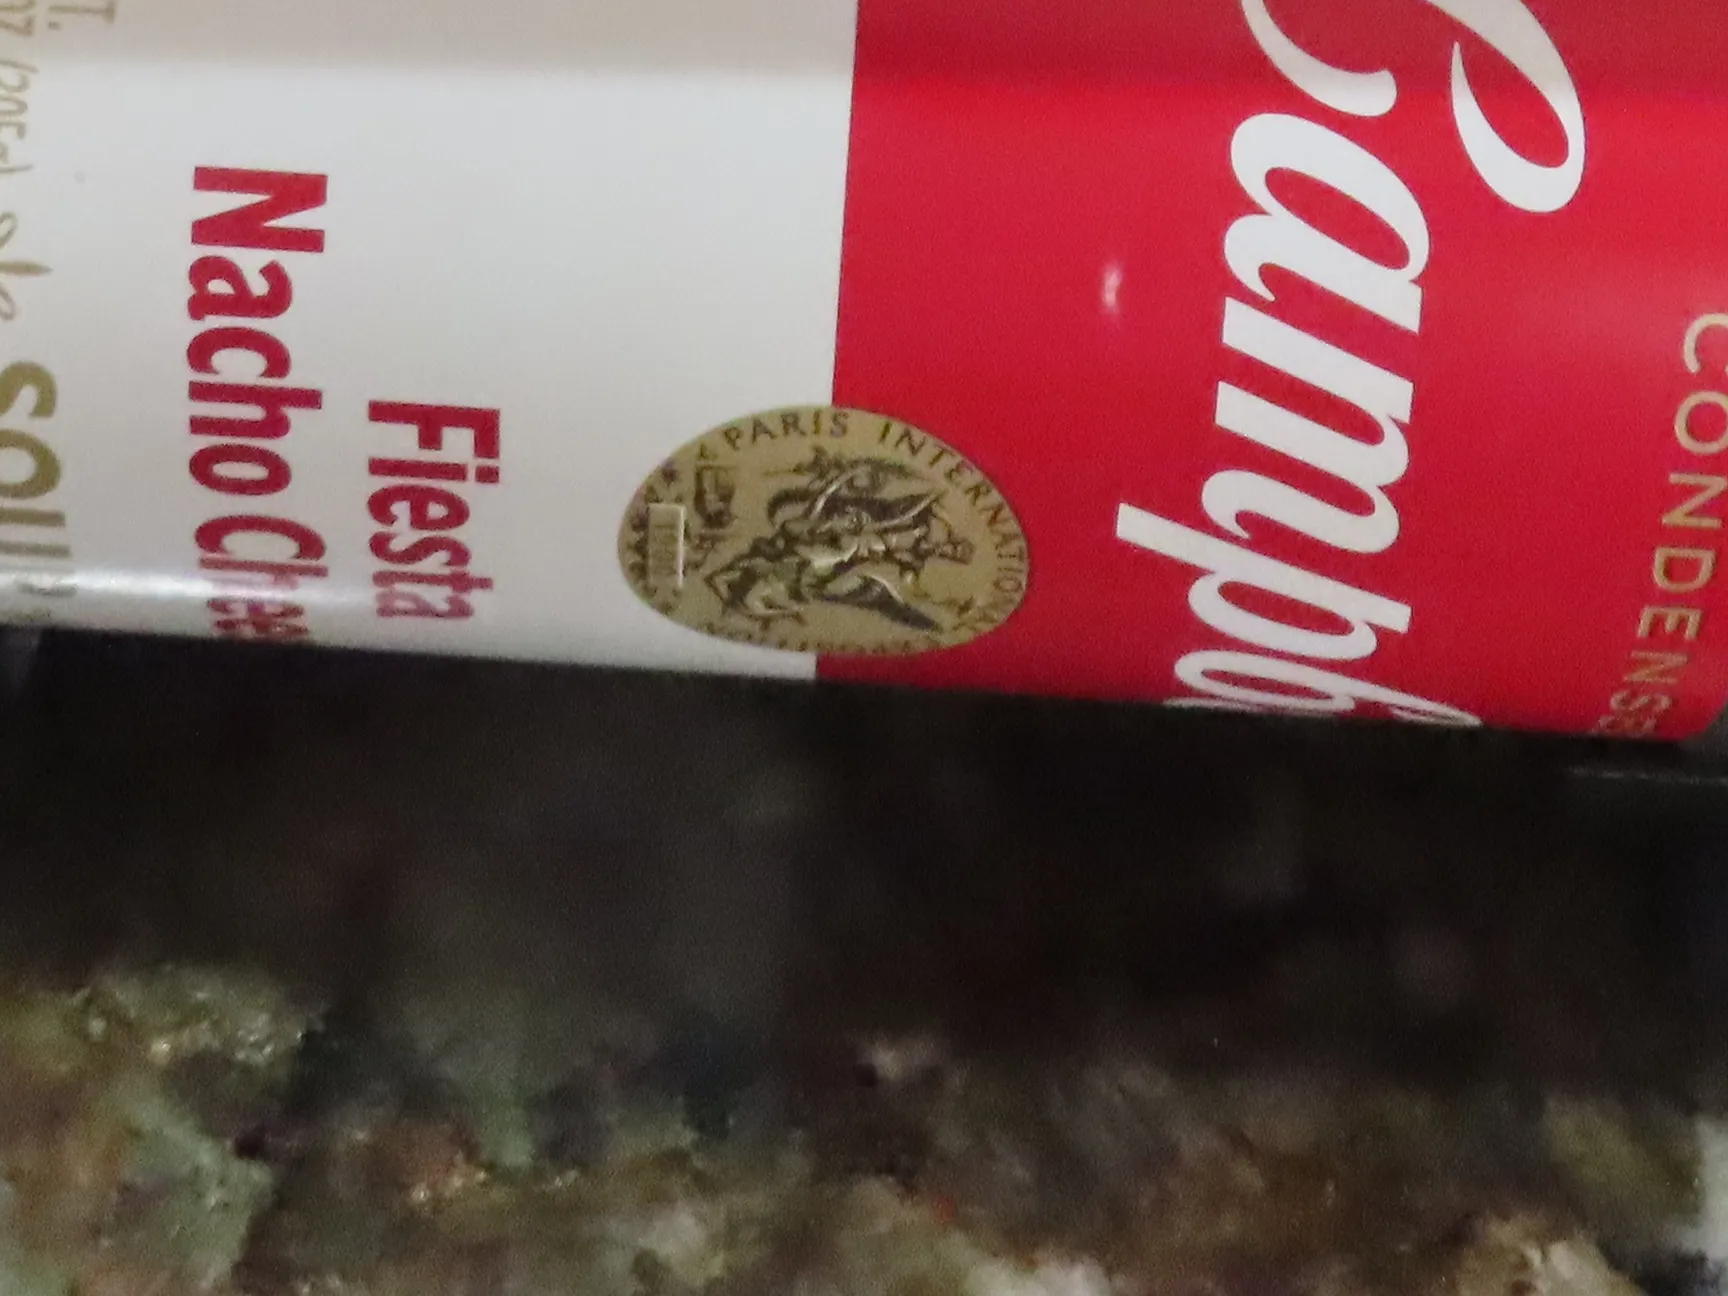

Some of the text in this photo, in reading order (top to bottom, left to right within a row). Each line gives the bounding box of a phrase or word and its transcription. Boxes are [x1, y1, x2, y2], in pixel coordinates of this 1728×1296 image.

[185, 164, 329, 496] Nacho
[724, 409, 851, 451] PARIS
[367, 399, 501, 620] Fiesta
